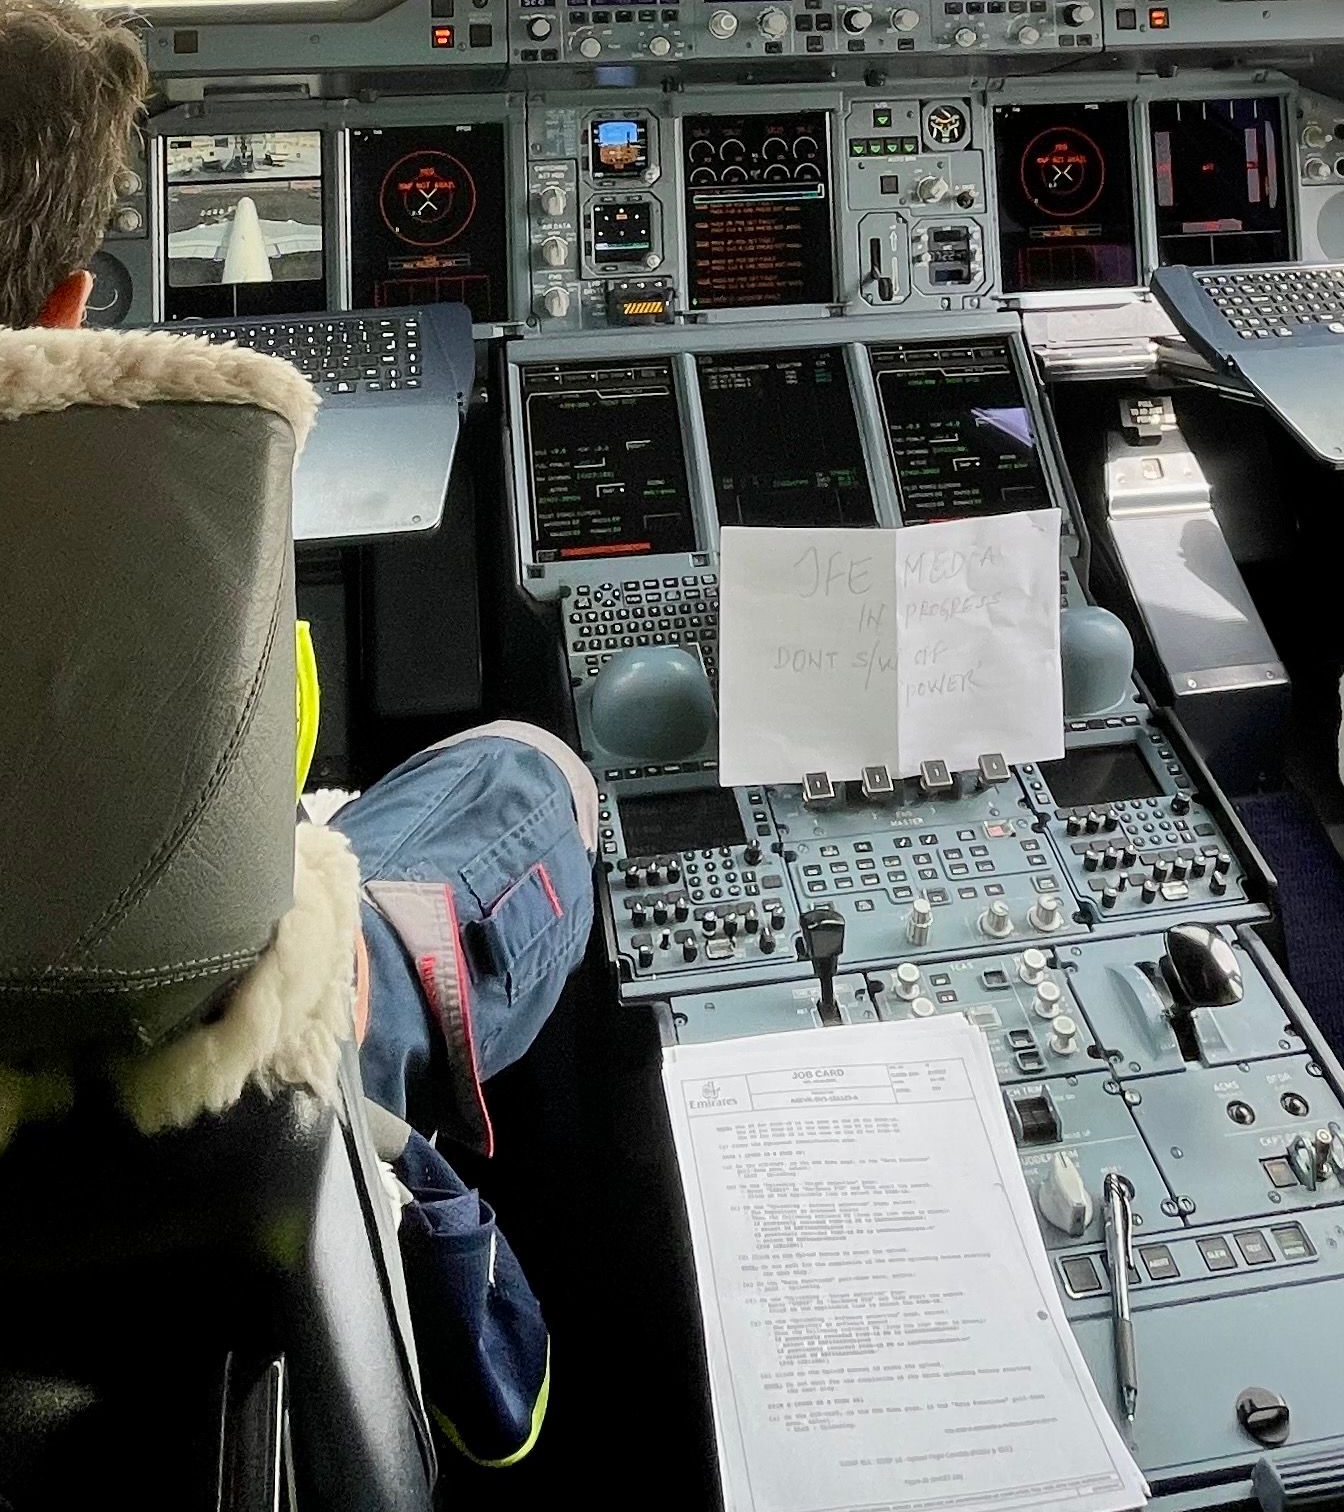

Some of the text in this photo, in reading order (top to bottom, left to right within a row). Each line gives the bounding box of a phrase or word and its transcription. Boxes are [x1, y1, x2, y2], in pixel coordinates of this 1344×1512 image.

[858, 602, 886, 633] IN
[774, 645, 839, 672] DONT
[890, 818, 924, 827] MASTER
[791, 1068, 845, 1081] JOB CARD
